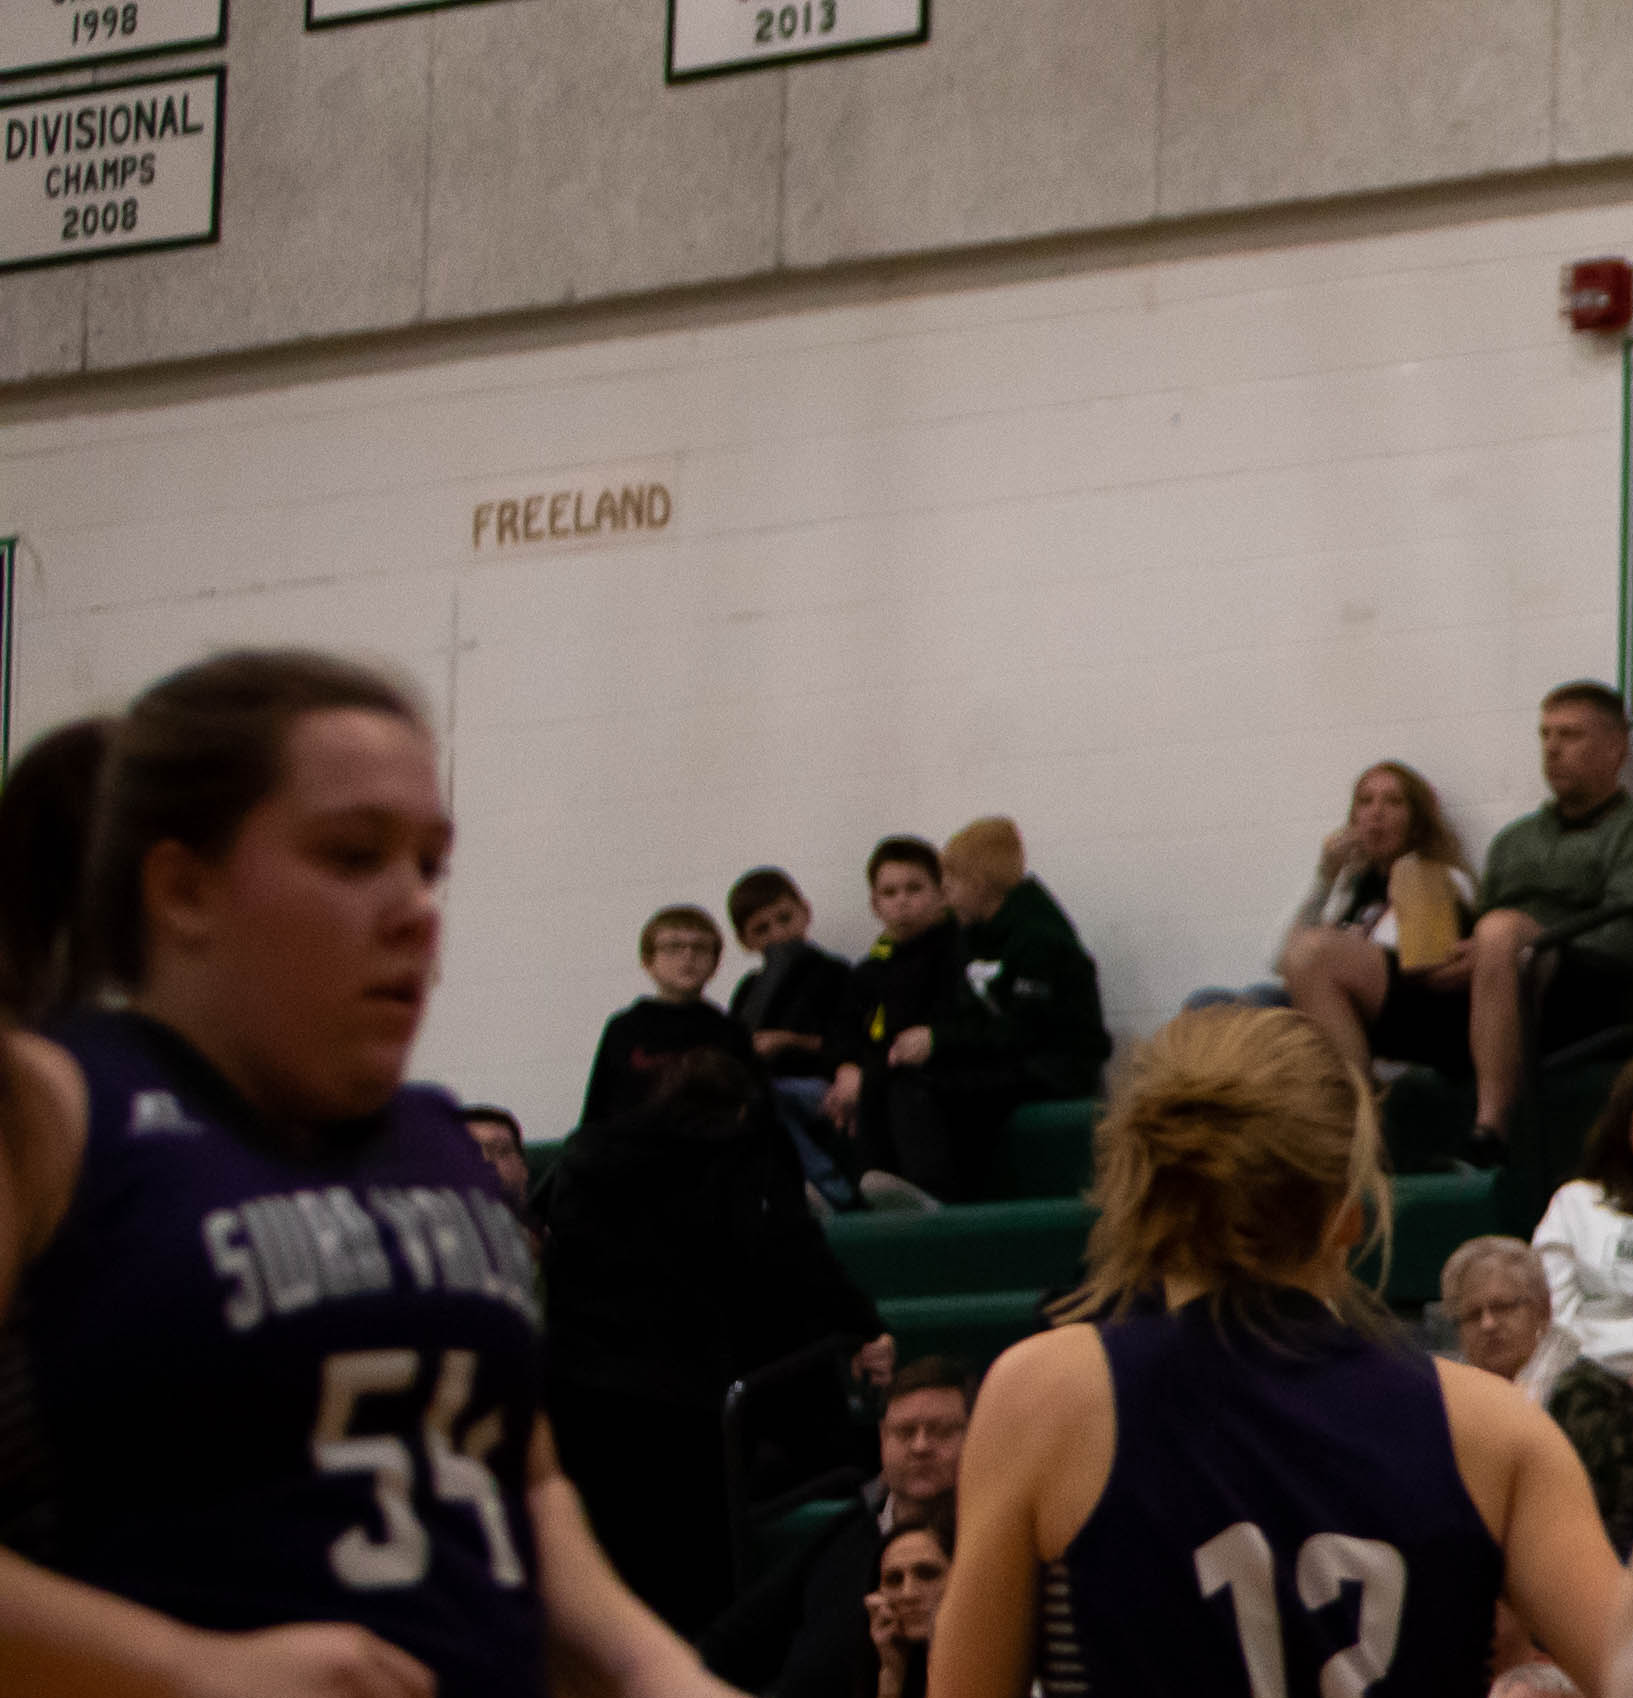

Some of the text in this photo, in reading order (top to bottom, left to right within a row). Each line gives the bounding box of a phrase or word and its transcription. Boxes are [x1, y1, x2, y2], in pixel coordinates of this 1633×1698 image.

[72, 3, 138, 44] 1998
[755, 0, 835, 42] 2013
[6, 94, 203, 161] DIVISIONAL
[46, 153, 155, 198] CHAMPS
[62, 198, 138, 240] 2008
[472, 482, 671, 548] FREELAND
[312, 1347, 525, 1592] 54
